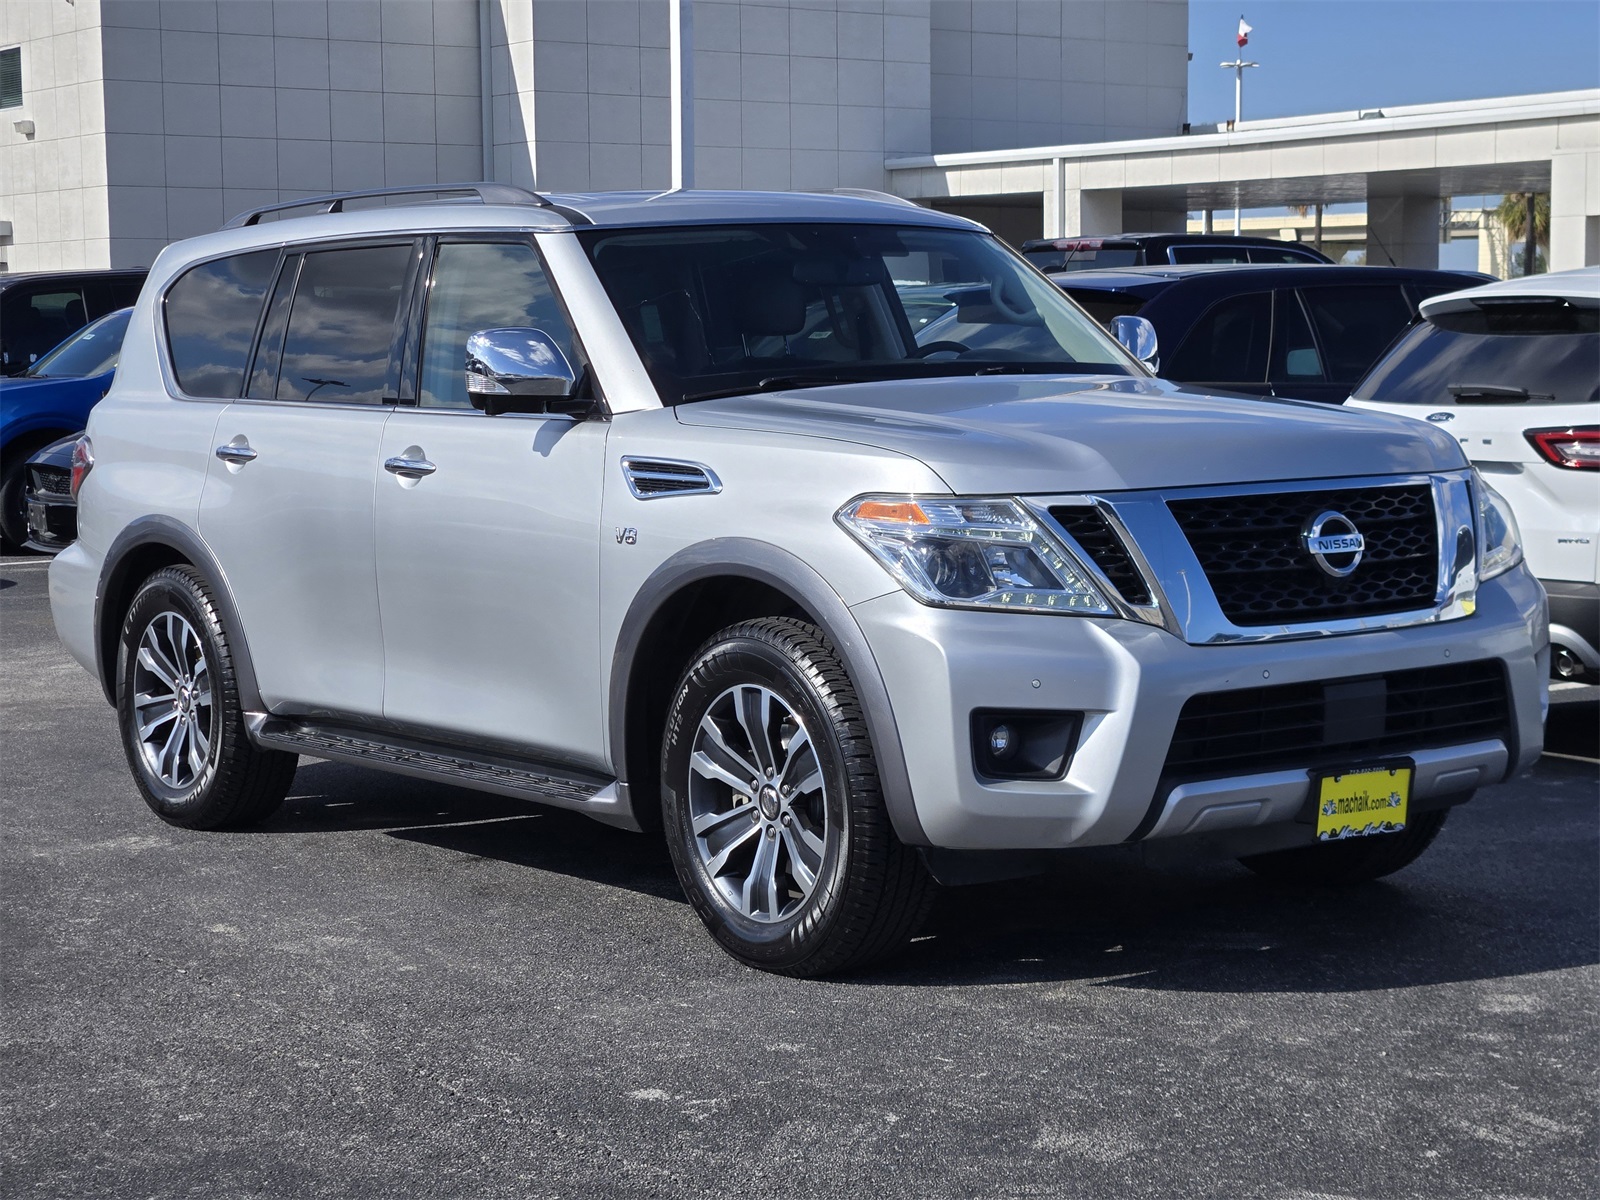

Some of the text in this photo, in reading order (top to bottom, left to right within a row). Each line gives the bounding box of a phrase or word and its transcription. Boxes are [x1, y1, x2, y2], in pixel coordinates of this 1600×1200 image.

[615, 527, 638, 545] V8
[1318, 537, 1363, 550] NISSAN
[662, 684, 689, 772] EVOLUTION
[1337, 790, 1387, 814] machaik.com
[1338, 824, 1361, 839] Mac
